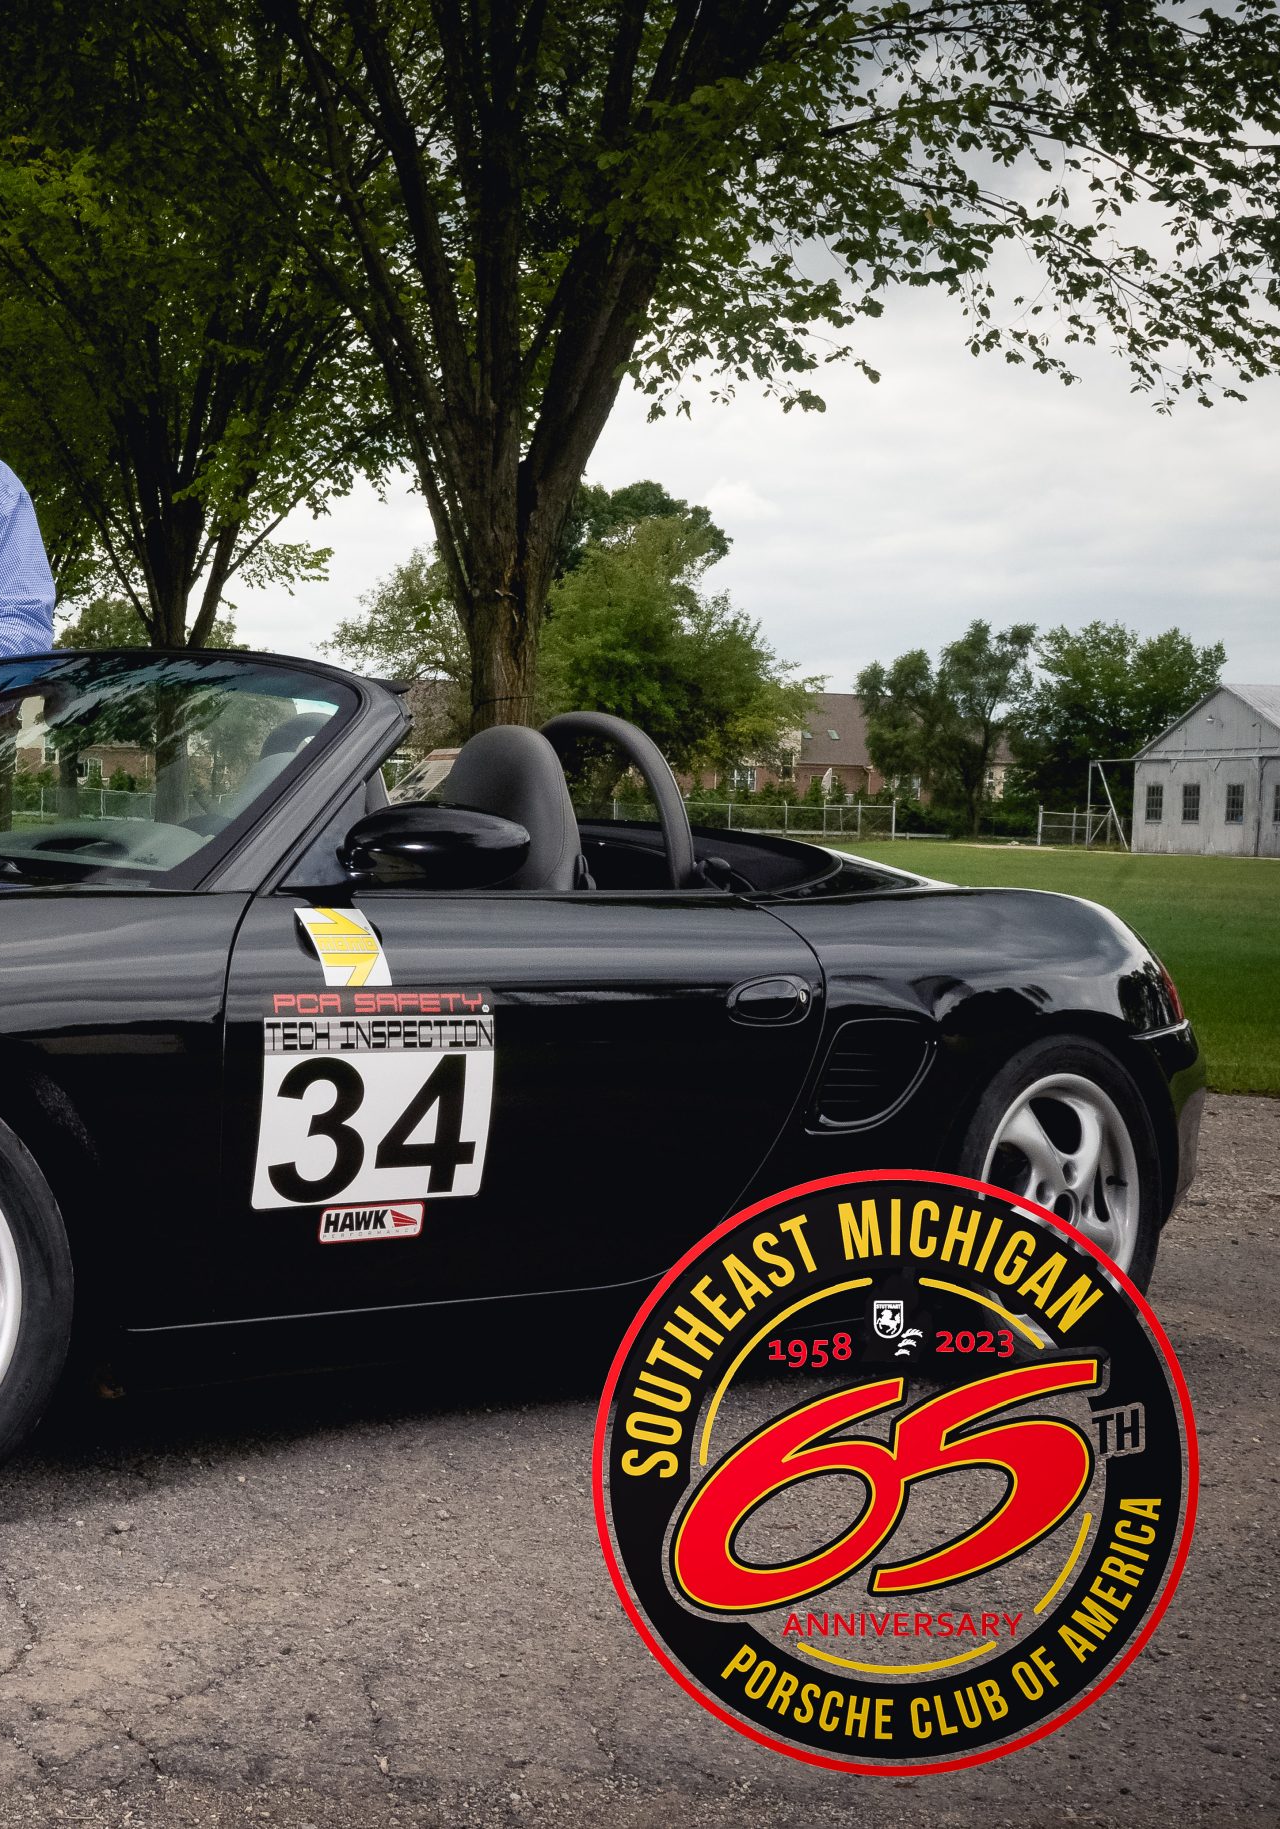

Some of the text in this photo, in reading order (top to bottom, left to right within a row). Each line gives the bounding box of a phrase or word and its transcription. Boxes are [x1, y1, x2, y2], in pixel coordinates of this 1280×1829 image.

[273, 992, 483, 1014] PCA SAFETY
[266, 1020, 494, 1050] TECH INSPECTION
[268, 1054, 476, 1203] 34
[324, 1209, 389, 1233] HAWK
